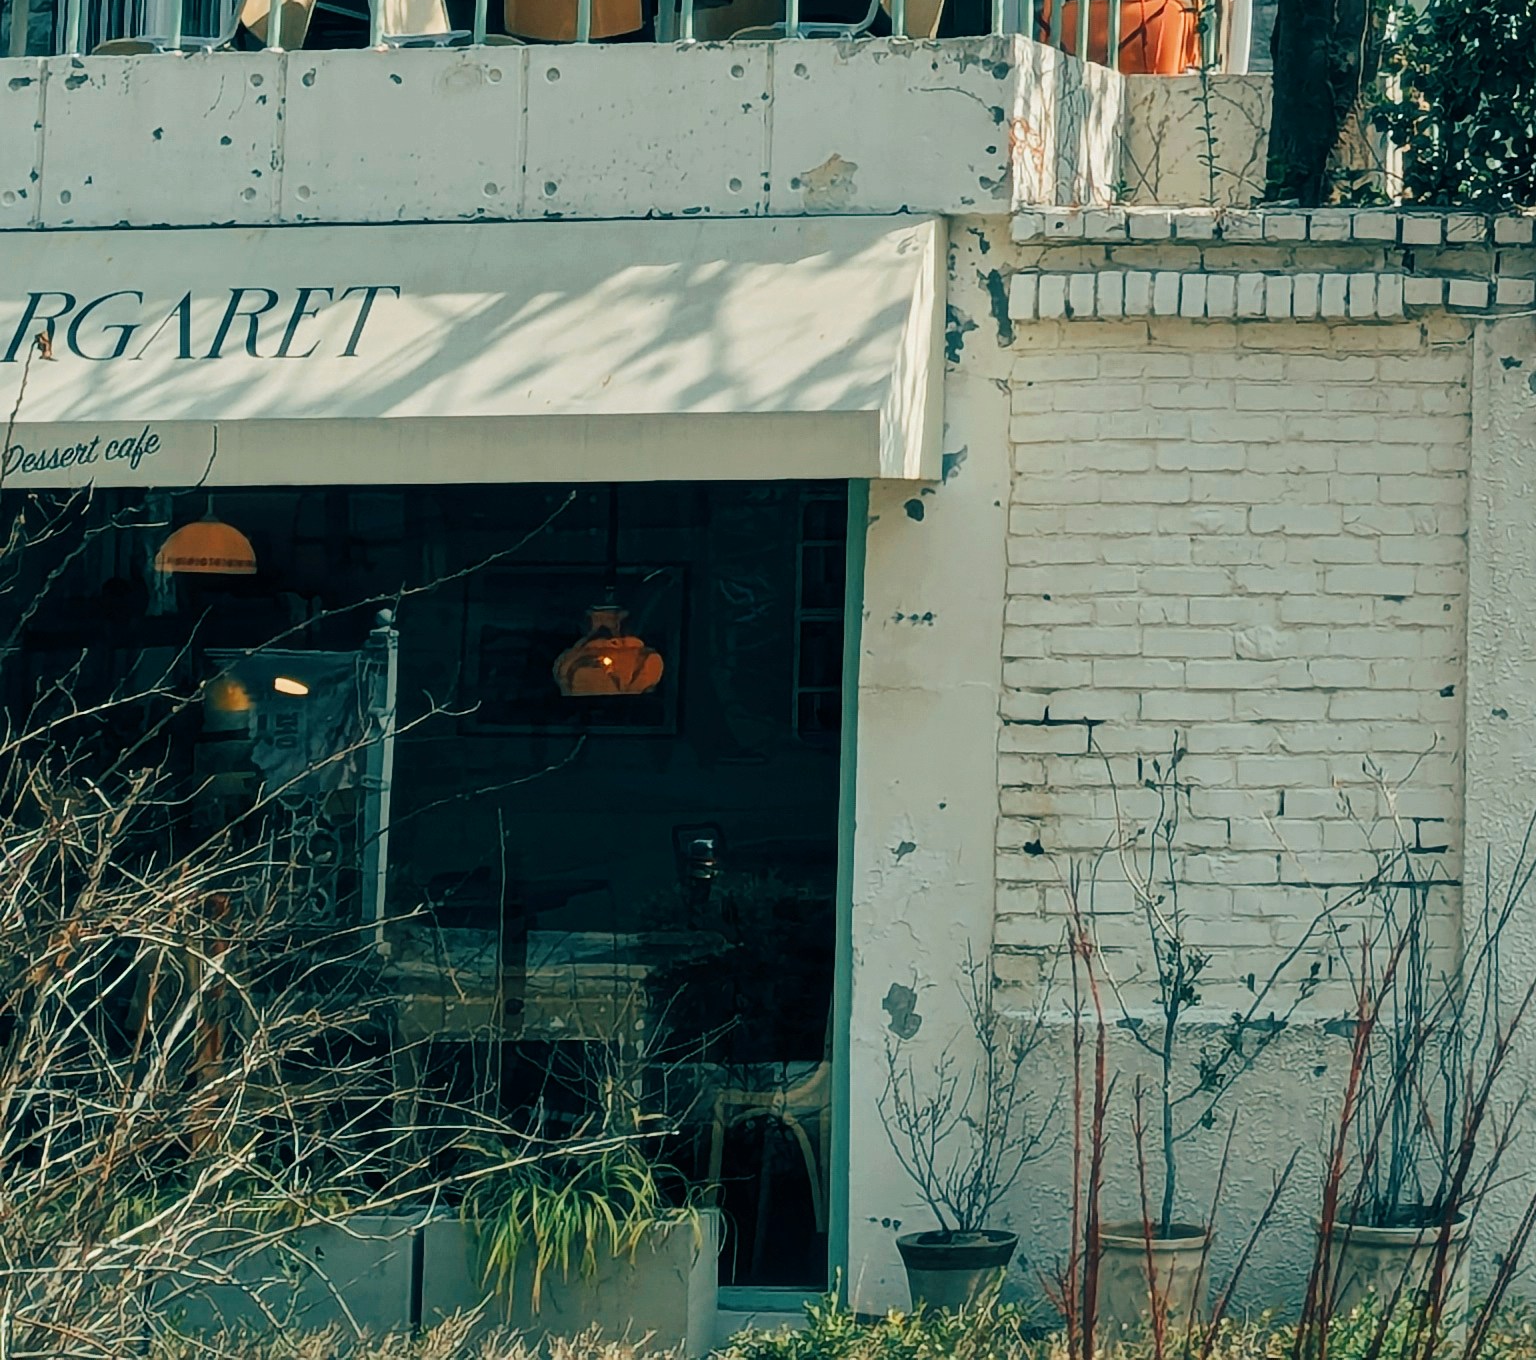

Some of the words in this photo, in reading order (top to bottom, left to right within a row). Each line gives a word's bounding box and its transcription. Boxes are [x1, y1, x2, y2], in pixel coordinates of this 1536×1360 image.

[0, 285, 400, 363] RGARET
[3, 435, 102, 477] Dessert
[105, 424, 161, 470] cafe
